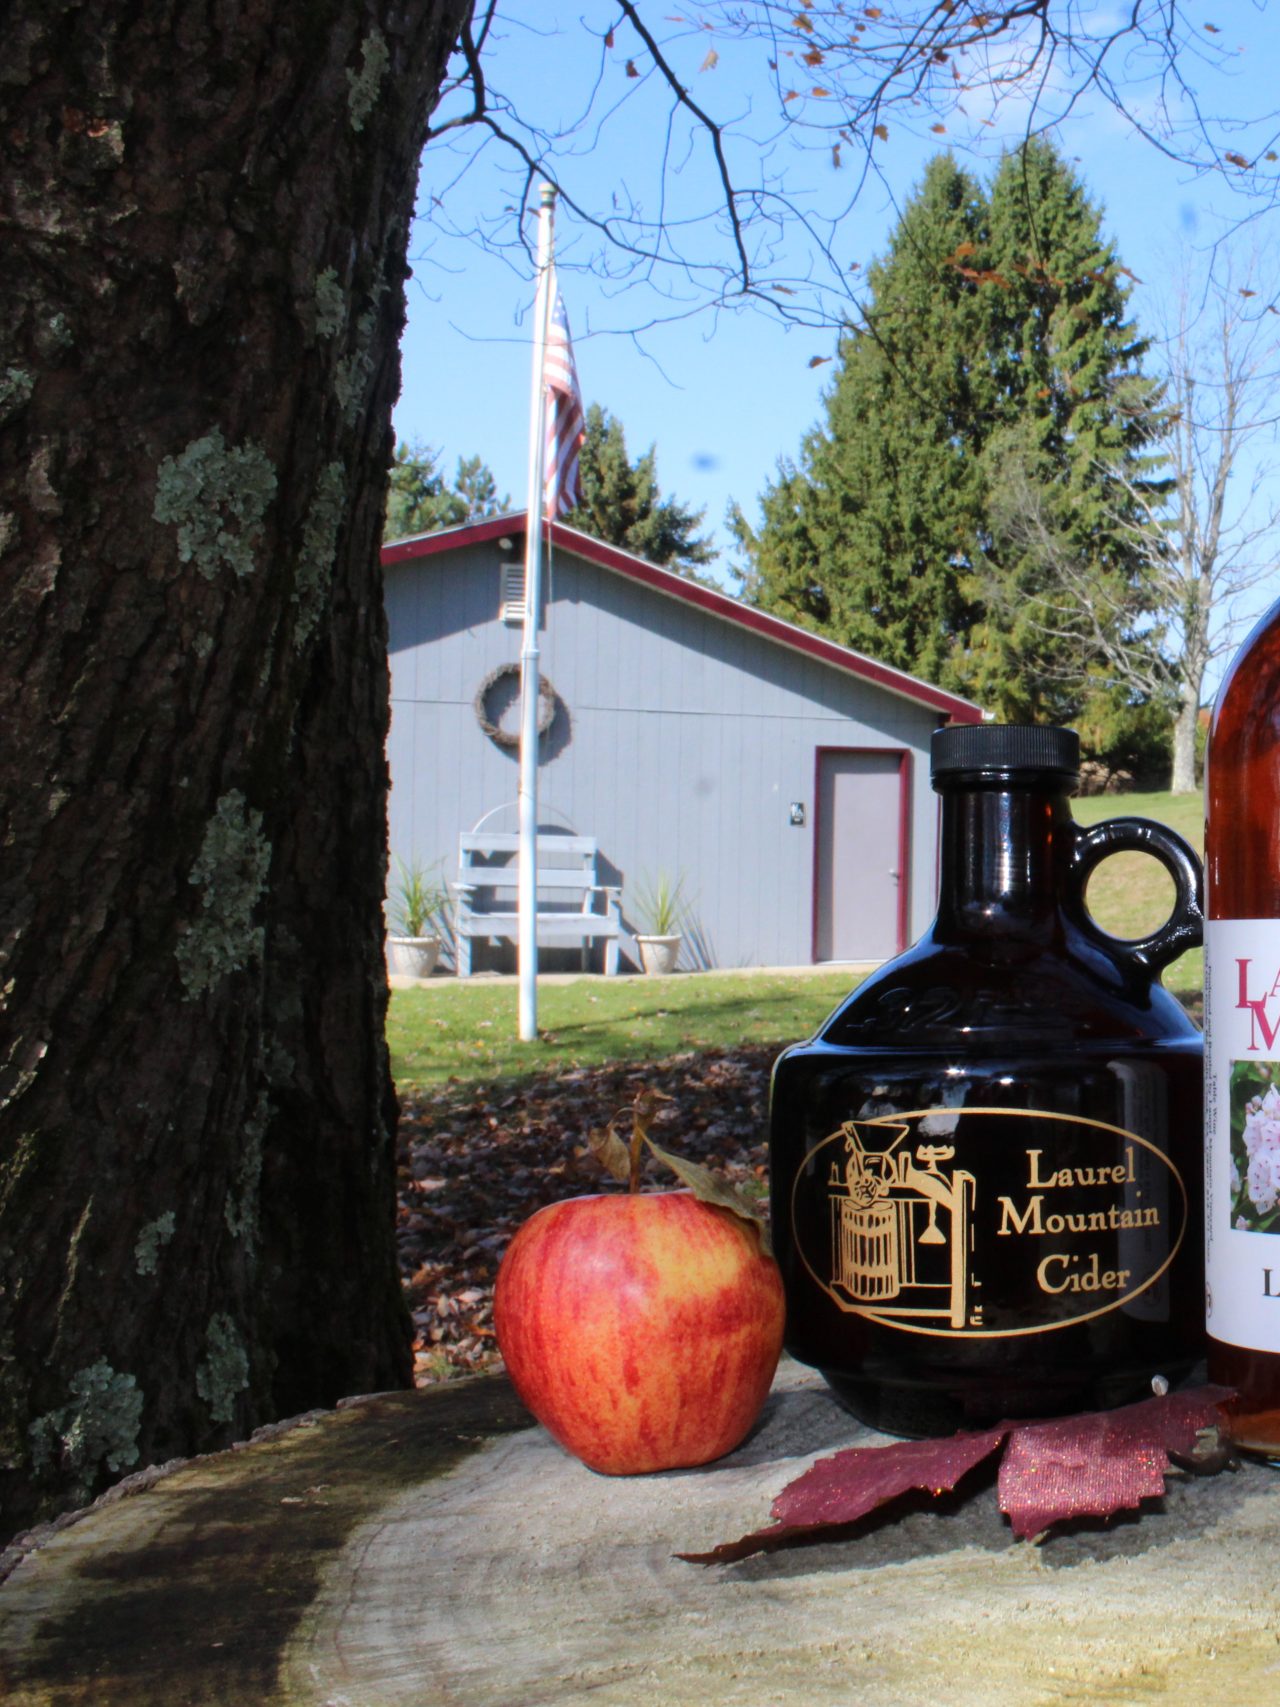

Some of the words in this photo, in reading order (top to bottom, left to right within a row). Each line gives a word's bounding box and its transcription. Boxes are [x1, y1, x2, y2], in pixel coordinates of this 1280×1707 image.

[1026, 1147, 1135, 1187] Laurel
[997, 1192, 1159, 1235] Mountain
[1037, 1254, 1130, 1294] Cider
